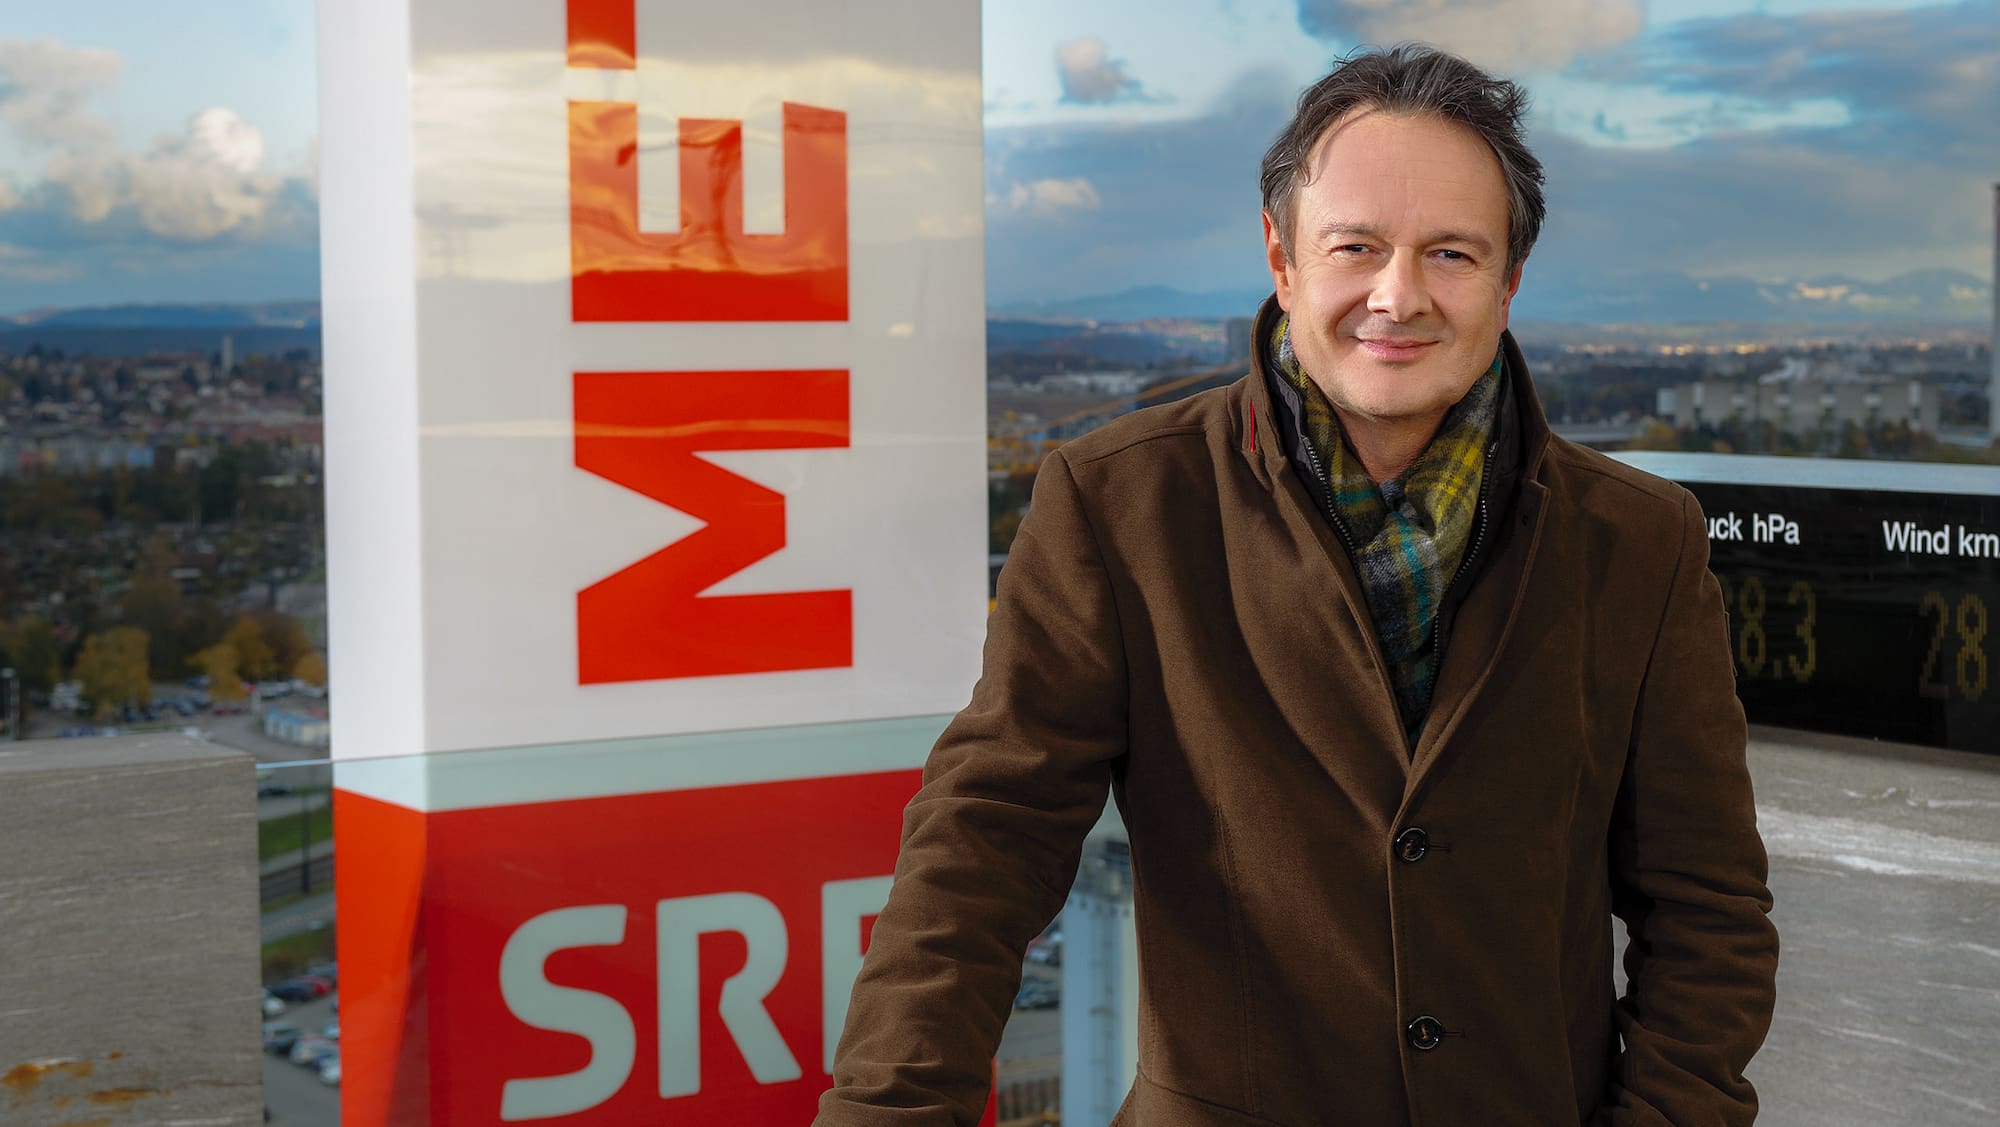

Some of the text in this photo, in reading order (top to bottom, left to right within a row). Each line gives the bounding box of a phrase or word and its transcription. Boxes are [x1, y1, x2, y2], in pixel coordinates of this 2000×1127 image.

[1752, 513, 1800, 545] hPa
[1882, 520, 2000, 558] Wind km
[1721, 574, 1816, 683] 8.3
[1919, 591, 1987, 702] 28
